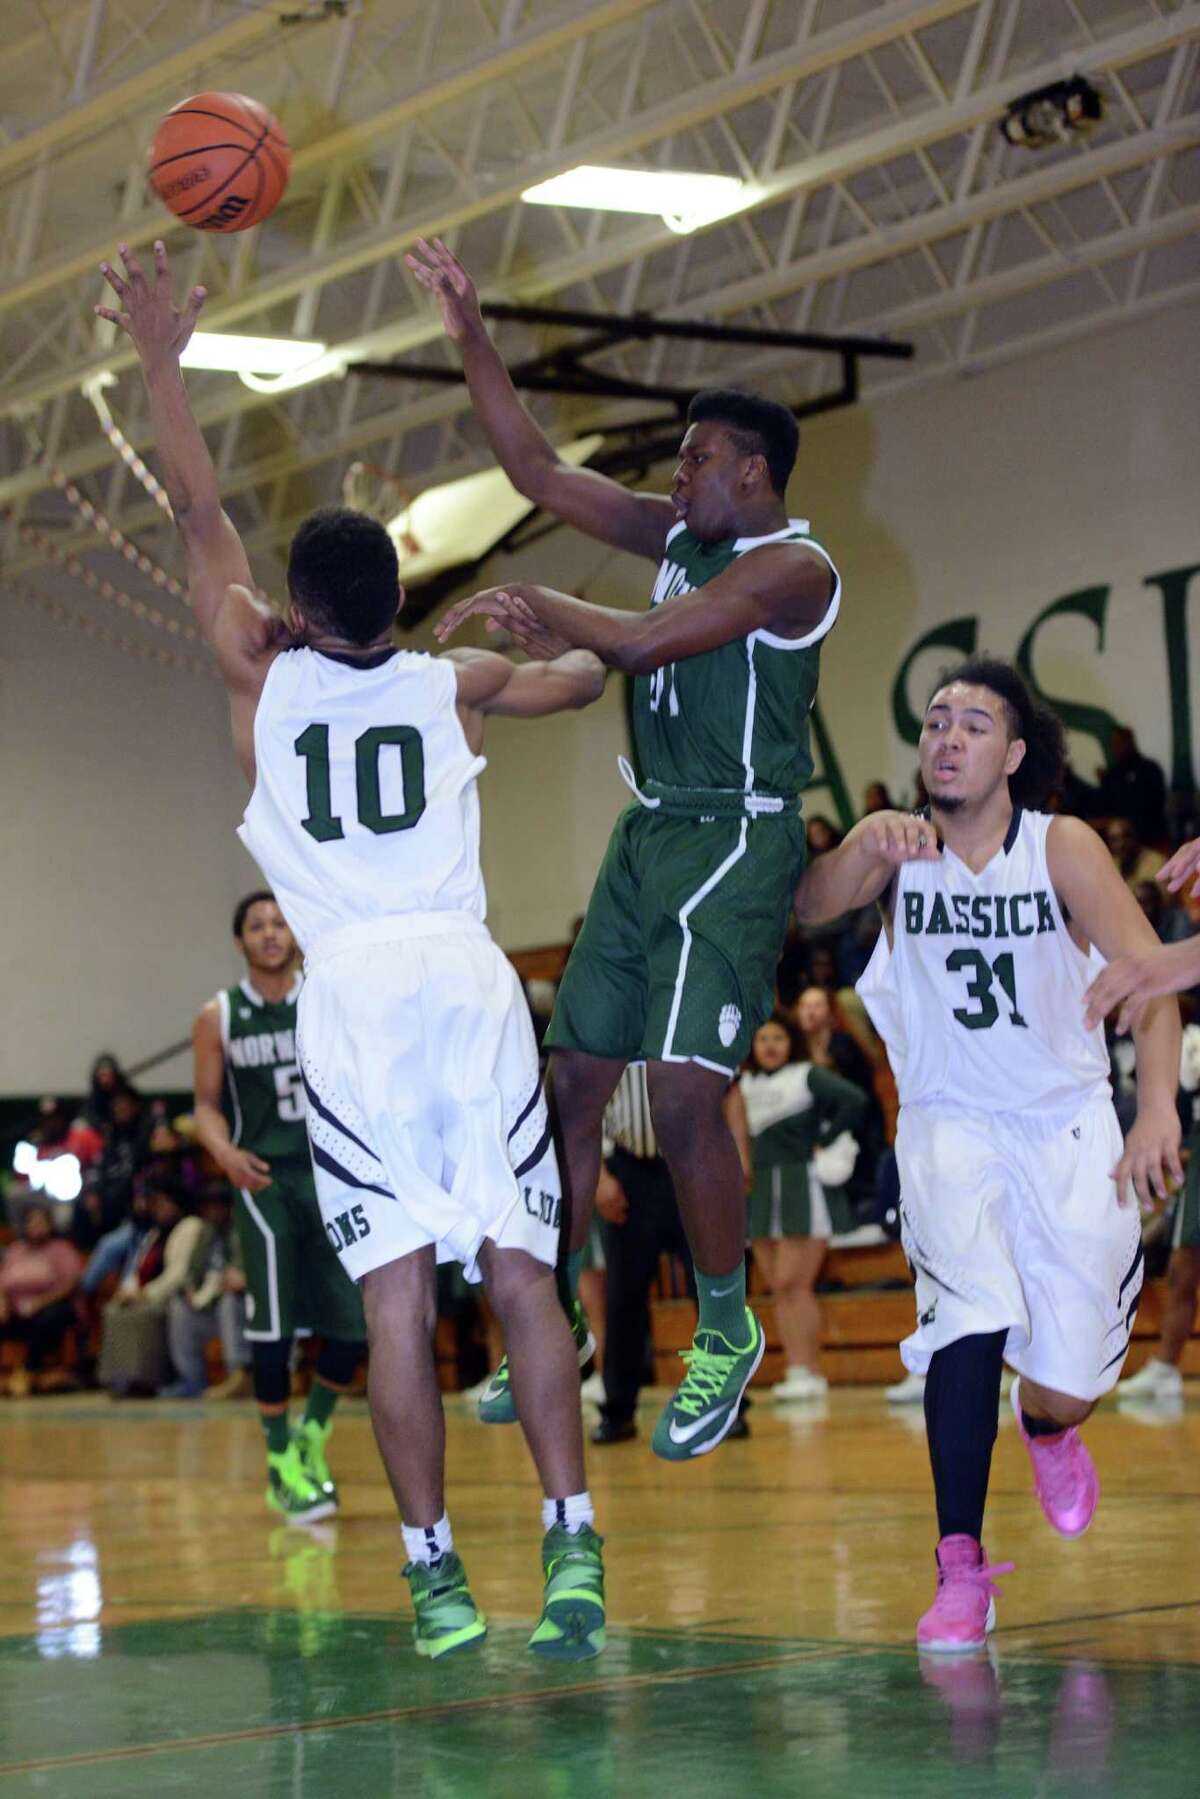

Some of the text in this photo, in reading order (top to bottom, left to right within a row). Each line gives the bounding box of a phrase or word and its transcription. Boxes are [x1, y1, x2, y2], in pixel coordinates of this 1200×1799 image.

[294, 723, 427, 843] 10
[903, 891, 1057, 938] BASSICK
[945, 948, 1029, 1030] 31
[273, 1064, 306, 1122] 5
